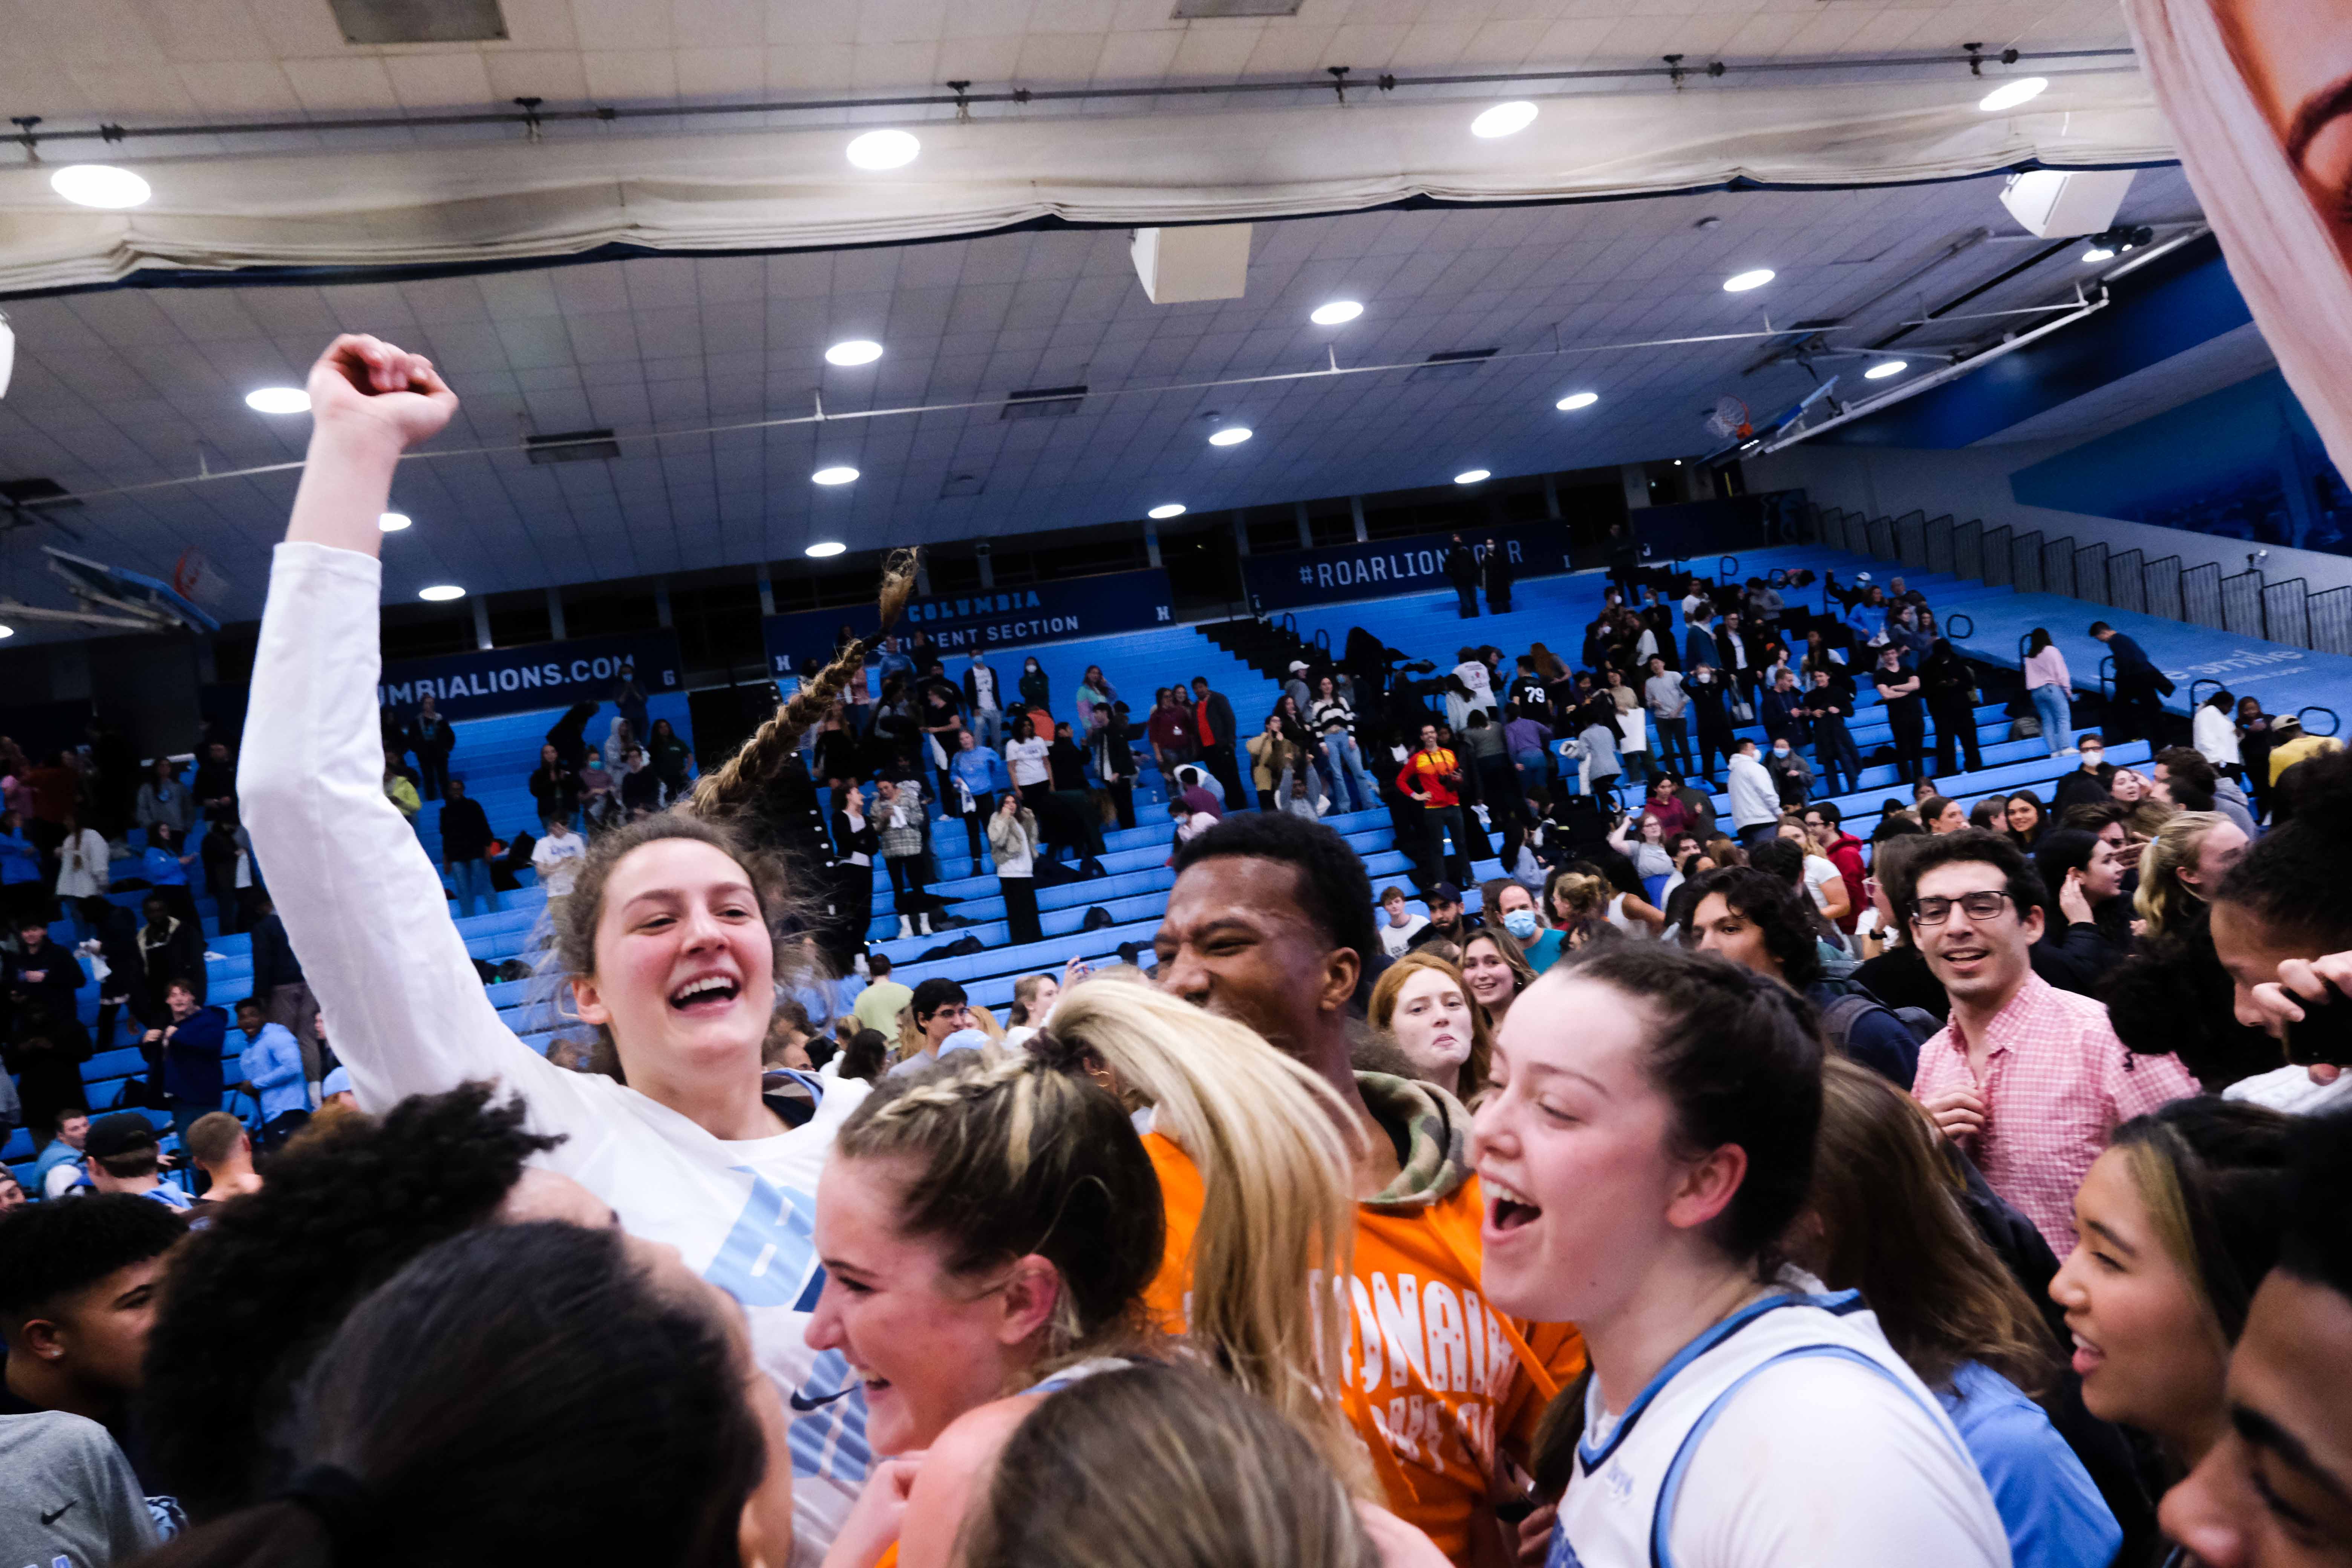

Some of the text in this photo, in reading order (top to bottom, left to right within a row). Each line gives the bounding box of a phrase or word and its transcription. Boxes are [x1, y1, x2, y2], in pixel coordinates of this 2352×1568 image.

[908, 591, 1041, 623] COLUMBIA
[1156, 606, 1171, 621] H
[986, 615, 1079, 641] SECTION
[776, 655, 792, 671] H
[1524, 686, 1545, 703] 79
